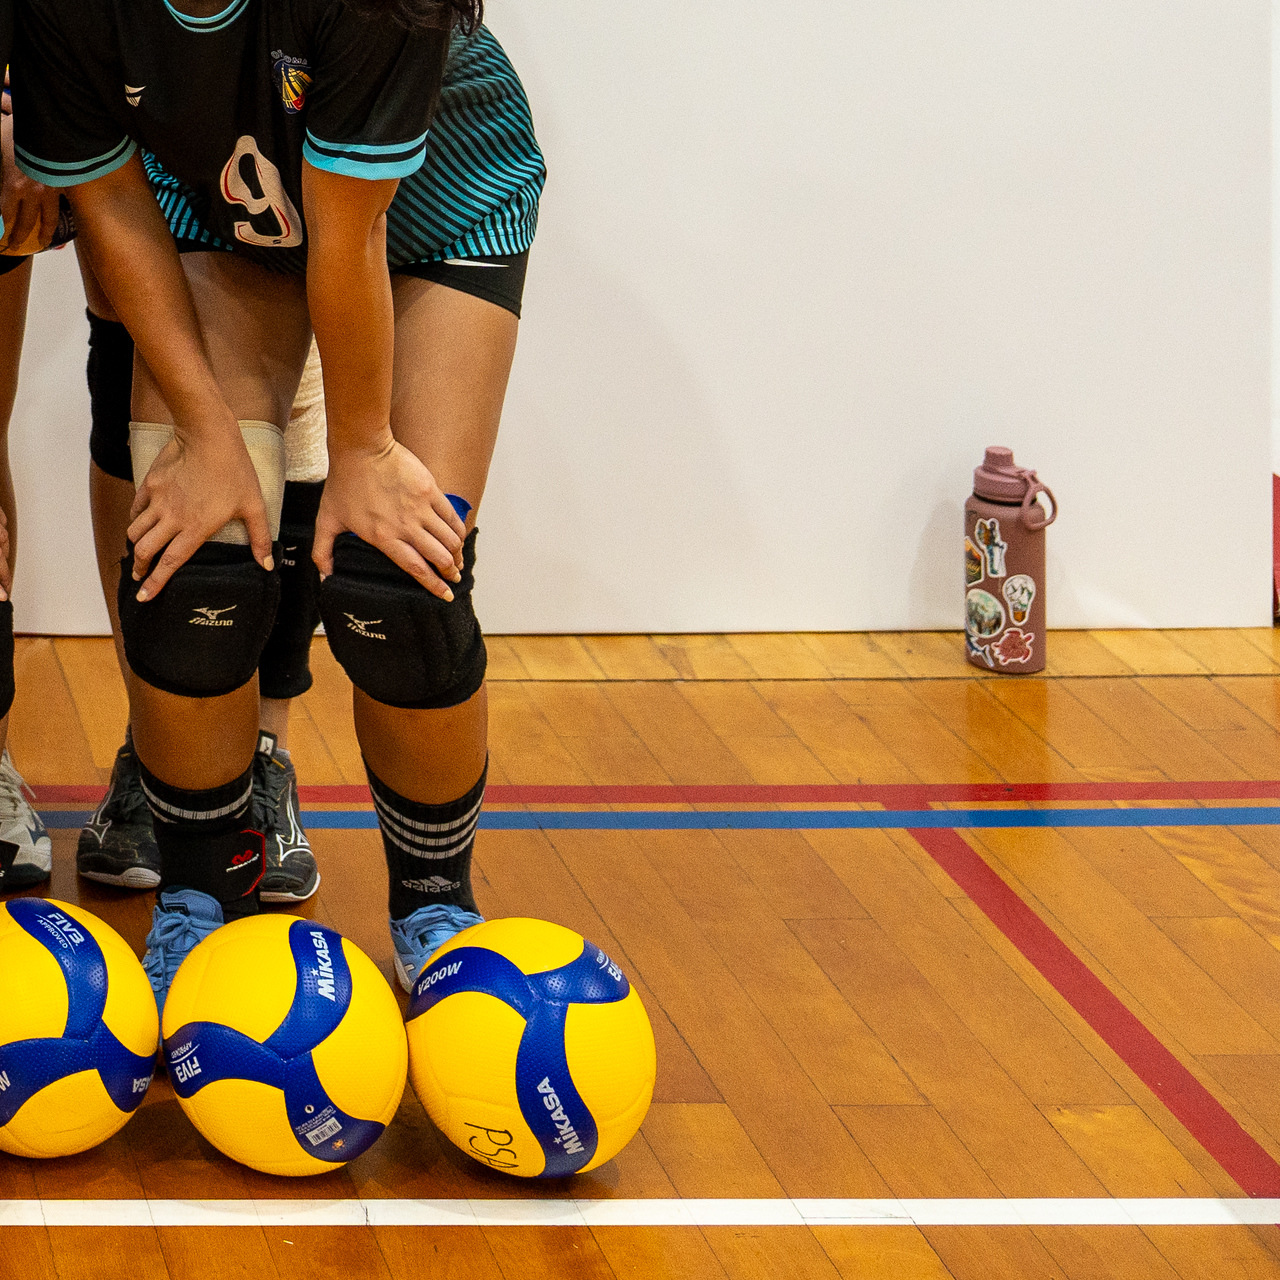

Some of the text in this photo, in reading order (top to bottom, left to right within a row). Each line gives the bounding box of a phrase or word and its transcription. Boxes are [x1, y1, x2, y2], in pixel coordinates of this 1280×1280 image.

[220, 135, 303, 248] 9
[310, 931, 336, 1002] MIKASA
[417, 960, 463, 996] V200W
[536, 1077, 585, 1155] MIKASA
